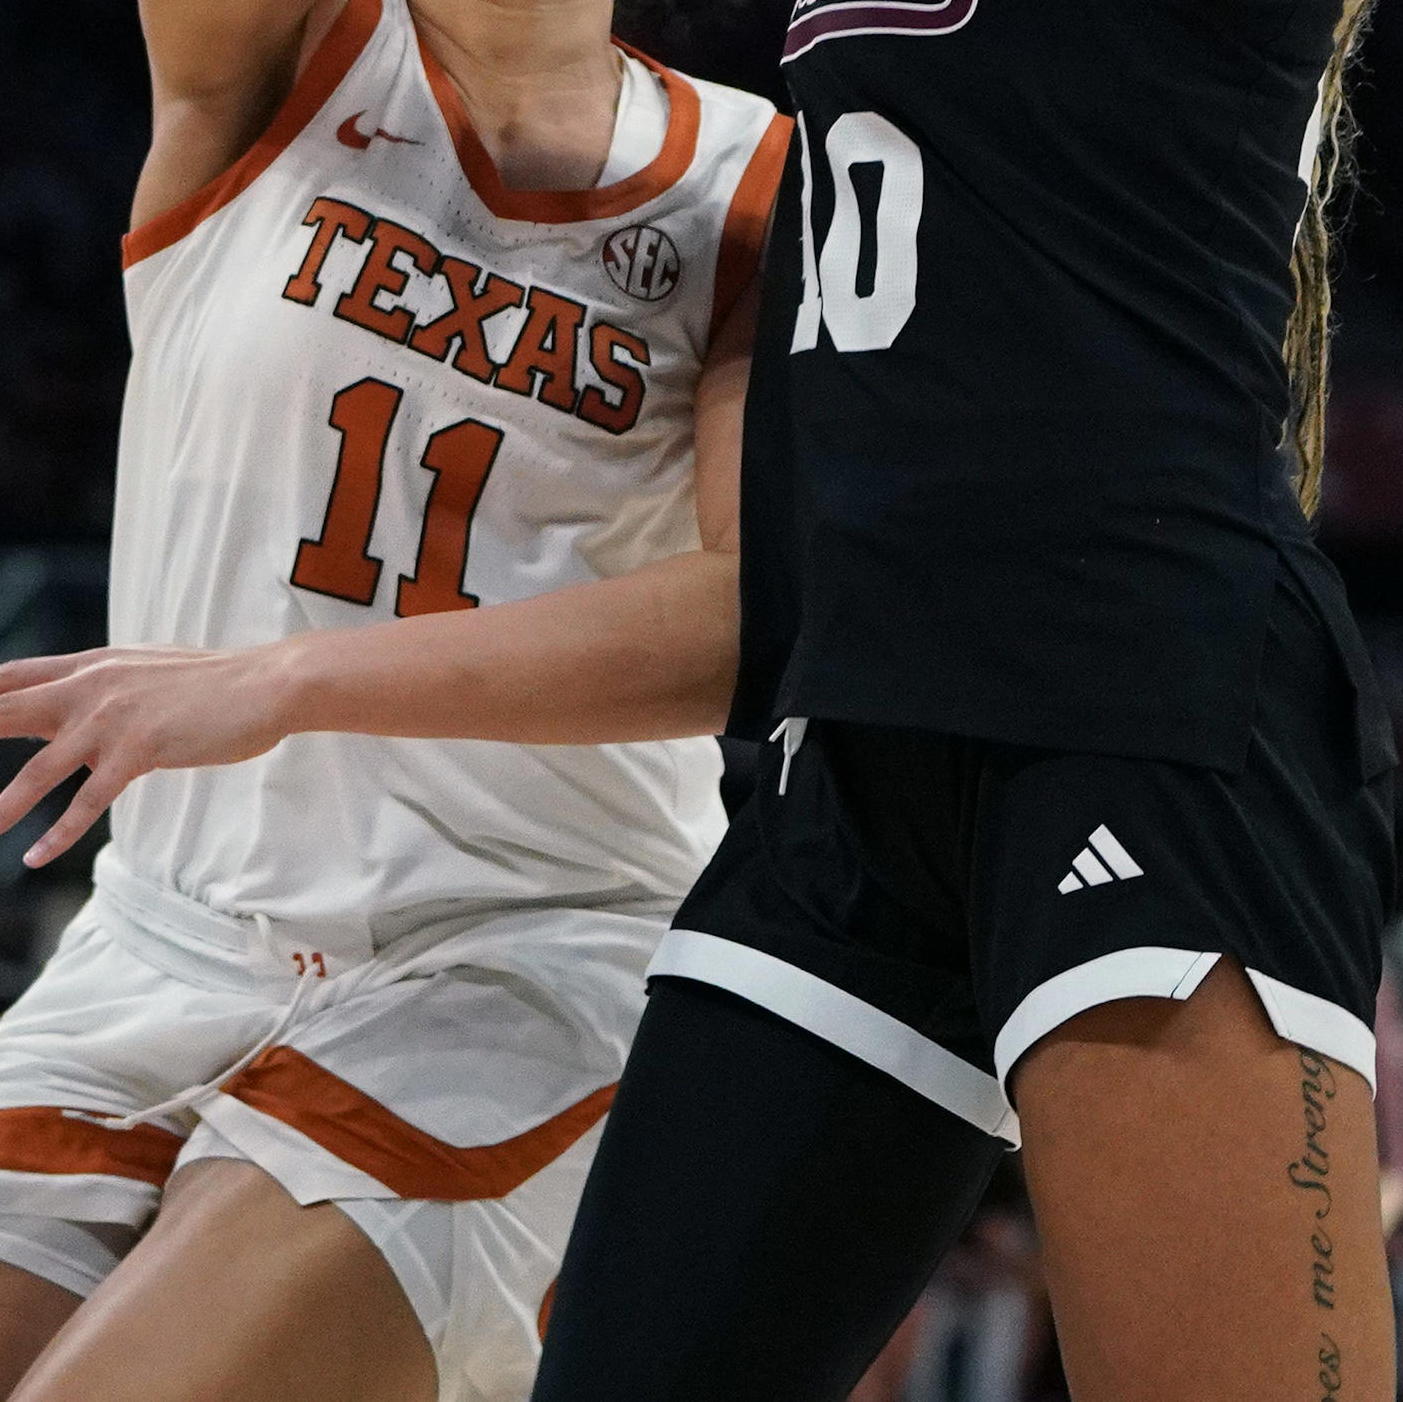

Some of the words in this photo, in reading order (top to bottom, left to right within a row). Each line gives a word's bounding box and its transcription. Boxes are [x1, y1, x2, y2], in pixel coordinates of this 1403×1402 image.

[282, 196, 652, 436] TEXAS
[603, 225, 679, 301] SEC
[290, 376, 505, 618] 11
[1310, 1226, 1336, 1311] me
